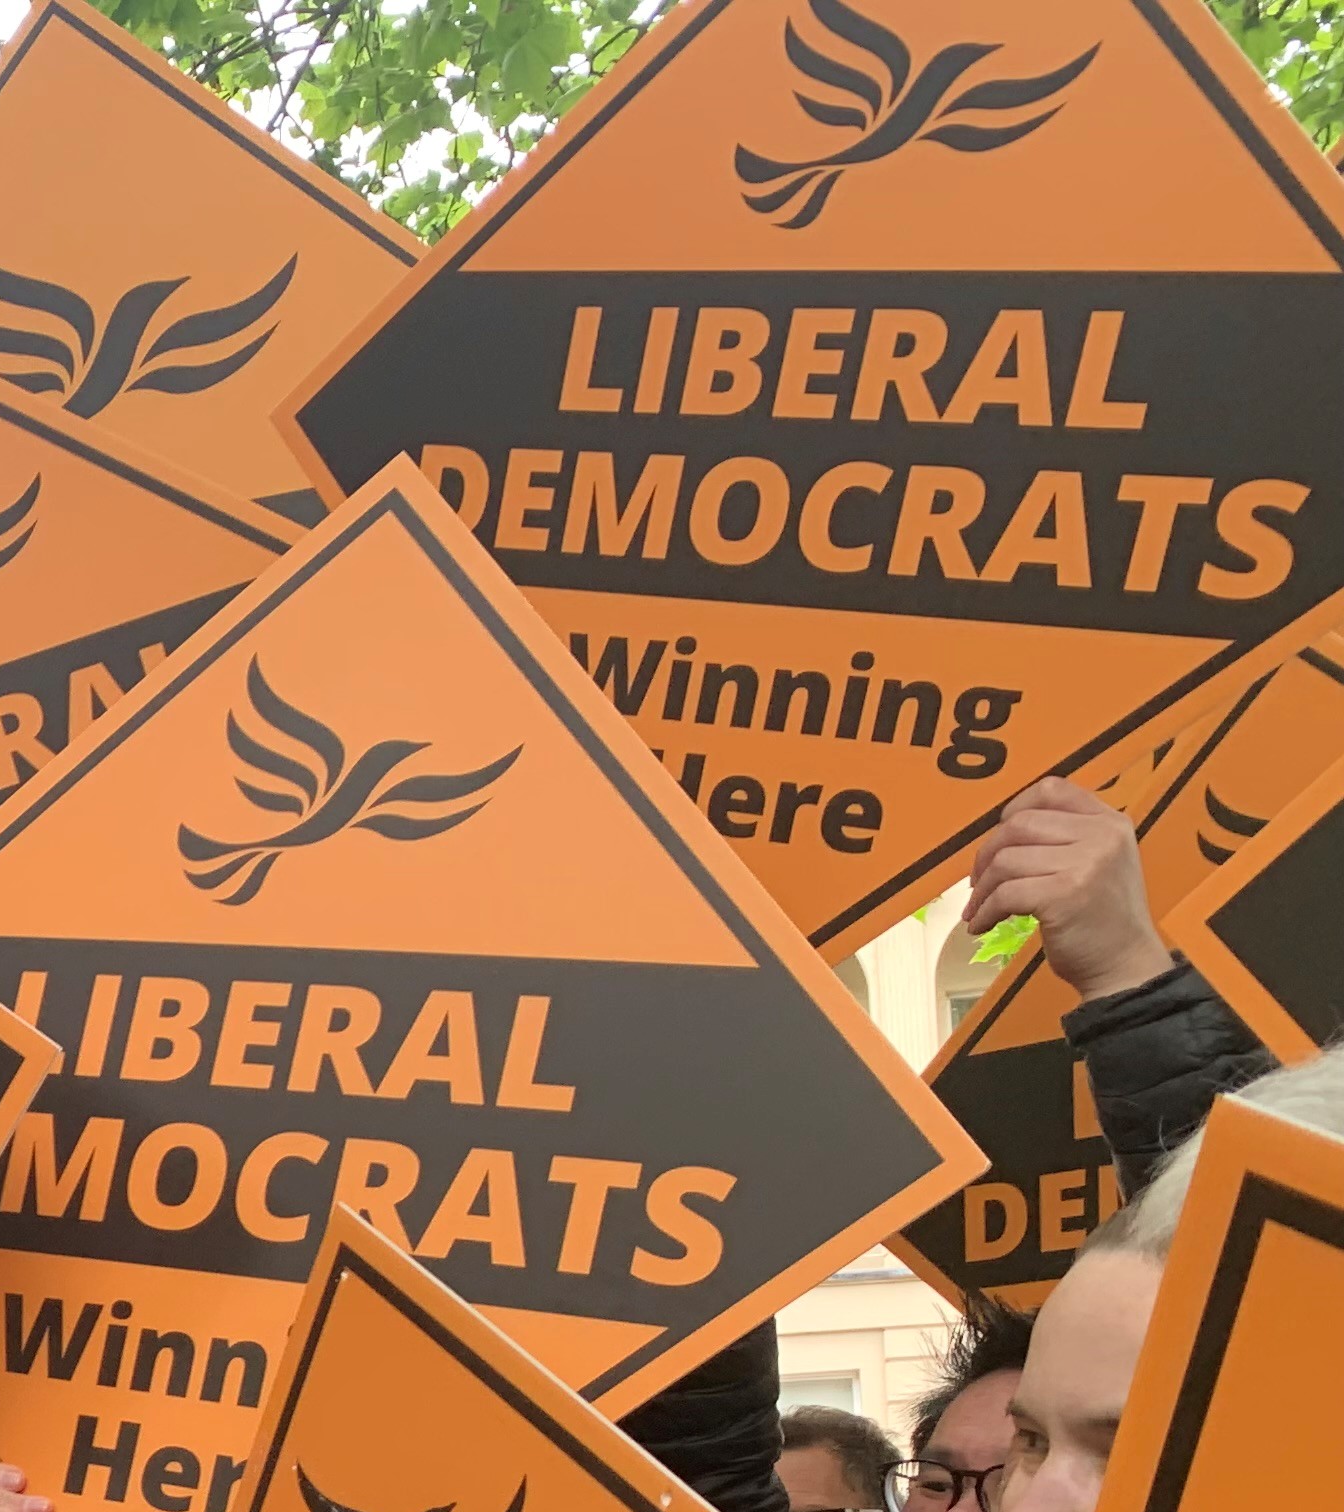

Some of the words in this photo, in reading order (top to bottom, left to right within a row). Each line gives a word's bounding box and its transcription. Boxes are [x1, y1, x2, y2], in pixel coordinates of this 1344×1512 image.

[558, 305, 1148, 430] LIBERAL
[419, 444, 1313, 600] DEMOCRATS
[570, 631, 1023, 780] Winning
